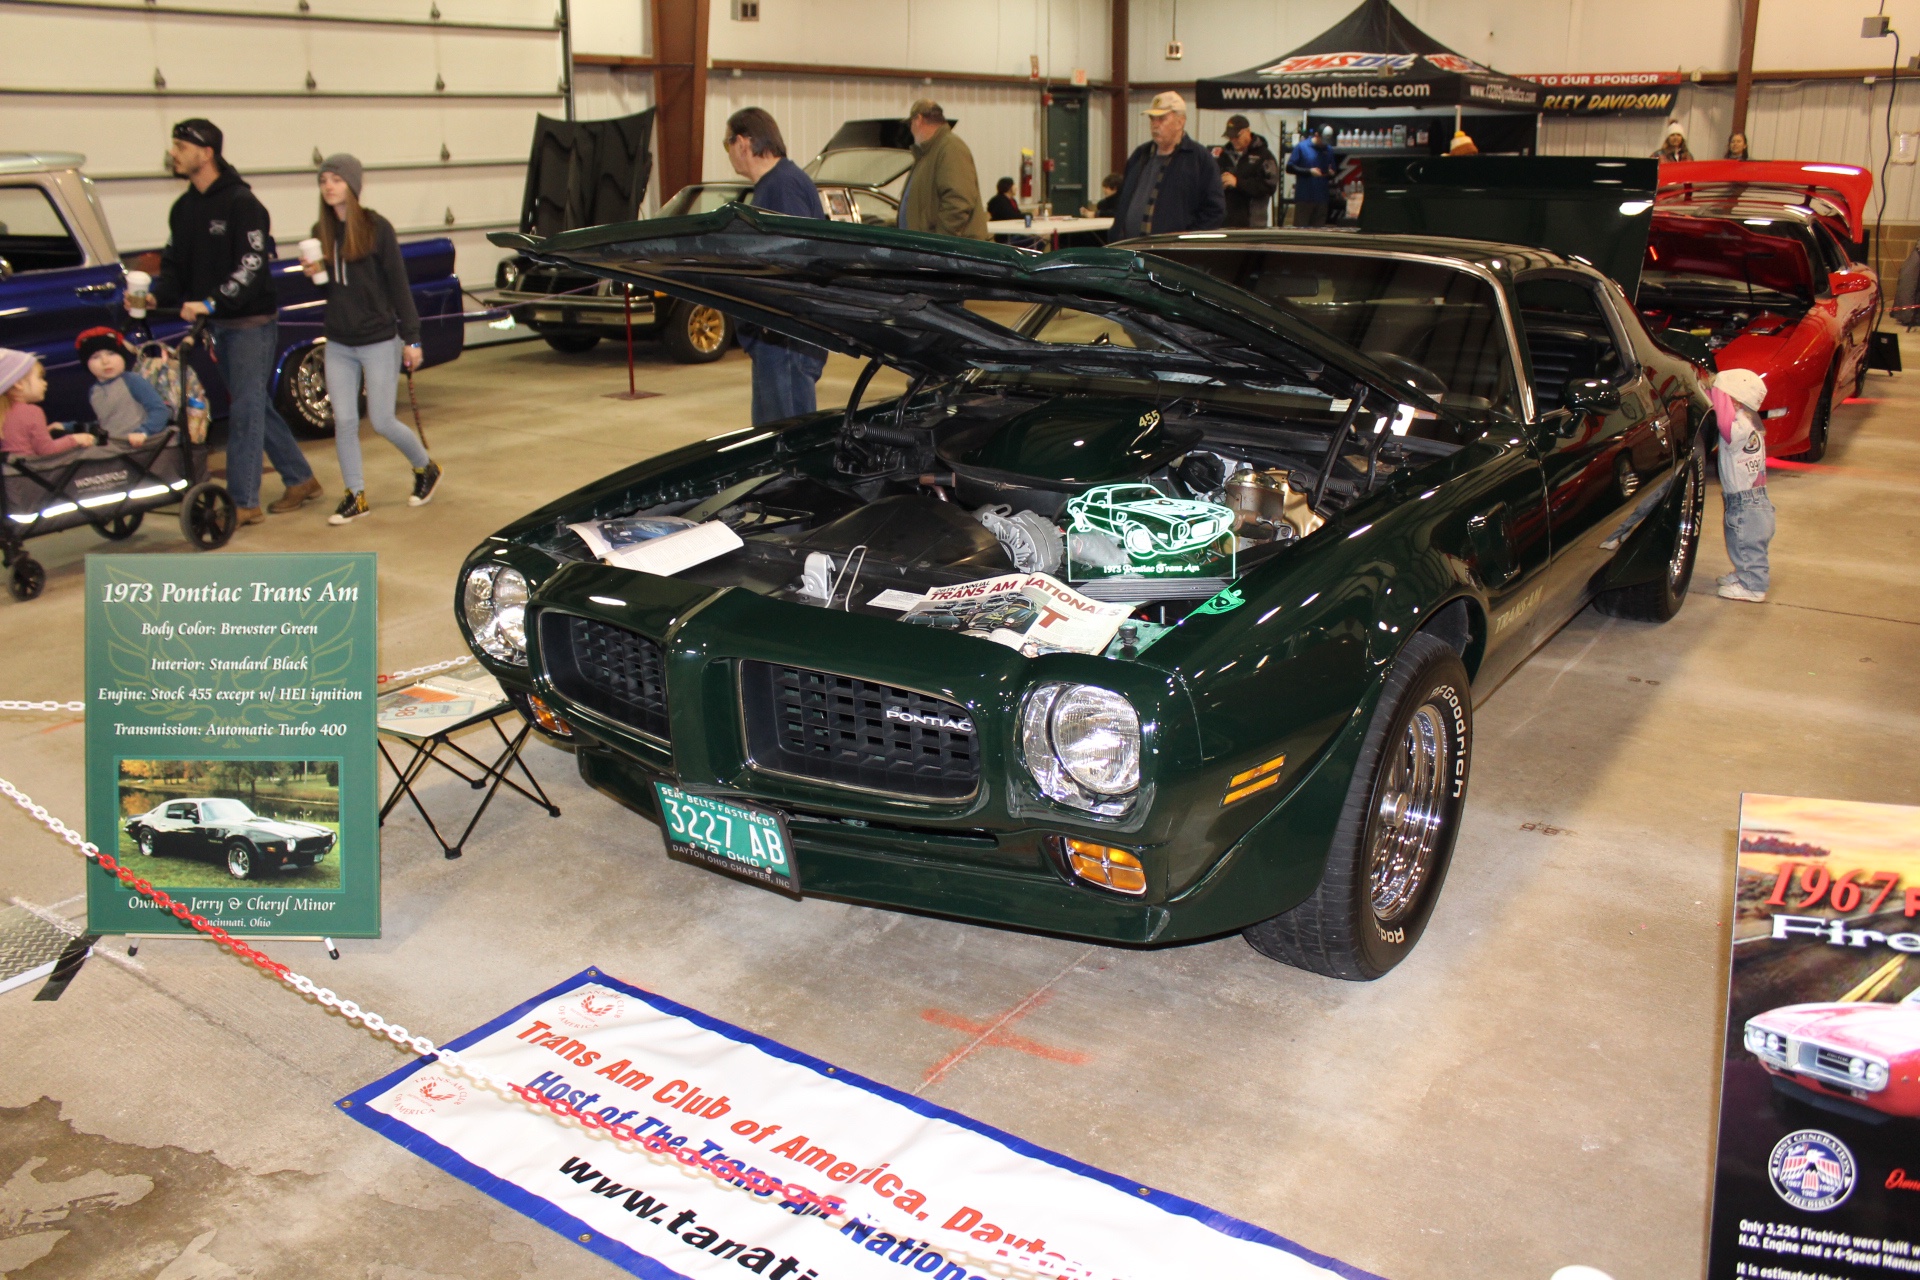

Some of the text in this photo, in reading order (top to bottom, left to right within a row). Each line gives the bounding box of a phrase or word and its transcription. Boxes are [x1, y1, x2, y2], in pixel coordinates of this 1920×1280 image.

[1540, 75, 1557, 86] TO
[1561, 75, 1590, 86] OUR
[1593, 74, 1659, 85] SPONSOR
[1221, 81, 1431, 102] www.1320Synthetics.com
[1543, 93, 1672, 110] RLEY DAVIDSON
[1138, 409, 1161, 428] 455
[102, 582, 359, 603] 1973 Pontiac Trans Am
[930, 585, 987, 601] TRANS
[988, 579, 1018, 595] AM
[141, 621, 318, 640] Body Color: Brewster Green
[151, 656, 308, 671] Interior: Standard Black
[98, 686, 363, 705] Engine: Stock 455 except w/ HEI ignition
[114, 721, 347, 736] Transmission: Automatic Turbo 400
[886, 709, 973, 732] PONTIAC
[1428, 684, 1467, 798] BFGoodrich
[661, 786, 684, 799] SEAT
[686, 794, 716, 811] BELTS
[717, 804, 777, 828] FASTENED?
[664, 798, 785, 865] 3227 AB
[672, 844, 705, 860] DAYTON
[707, 855, 728, 868] OHIO
[775, 876, 791, 889] INC
[726, 850, 760, 868] OHIO
[1764, 861, 1901, 915] 1967
[190, 896, 224, 915] Jerry
[228, 897, 243, 910] &
[246, 895, 293, 916] Cheryl
[292, 897, 337, 911] Minor
[249, 916, 272, 928] Ohio
[516, 1020, 600, 1067] Trans
[594, 1059, 654, 1092] Am
[652, 1079, 731, 1120] Club
[730, 1118, 783, 1144] of
[769, 1135, 930, 1222] America,
[525, 1071, 601, 1111] Host
[596, 1106, 639, 1129] of
[631, 1116, 688, 1153] The
[1784, 1191, 1837, 1209] FIREBIRD
[1739, 1219, 1765, 1235] Only
[1766, 1222, 1799, 1239] 3,236
[1800, 1226, 1850, 1246] Firebirds
[1852, 1235, 1881, 1251] were
[1882, 1238, 1910, 1256] built
[1738, 1233, 1761, 1248] H.O.
[1762, 1237, 1800, 1254] Engine
[1801, 1243, 1823, 1257] and
[1823, 1246, 1832, 1259] a
[1833, 1247, 1881, 1266] 4-Speed
[1736, 1261, 1747, 1274] It
[1748, 1262, 1759, 1277] is
[1760, 1266, 1817, 1280] estimated
